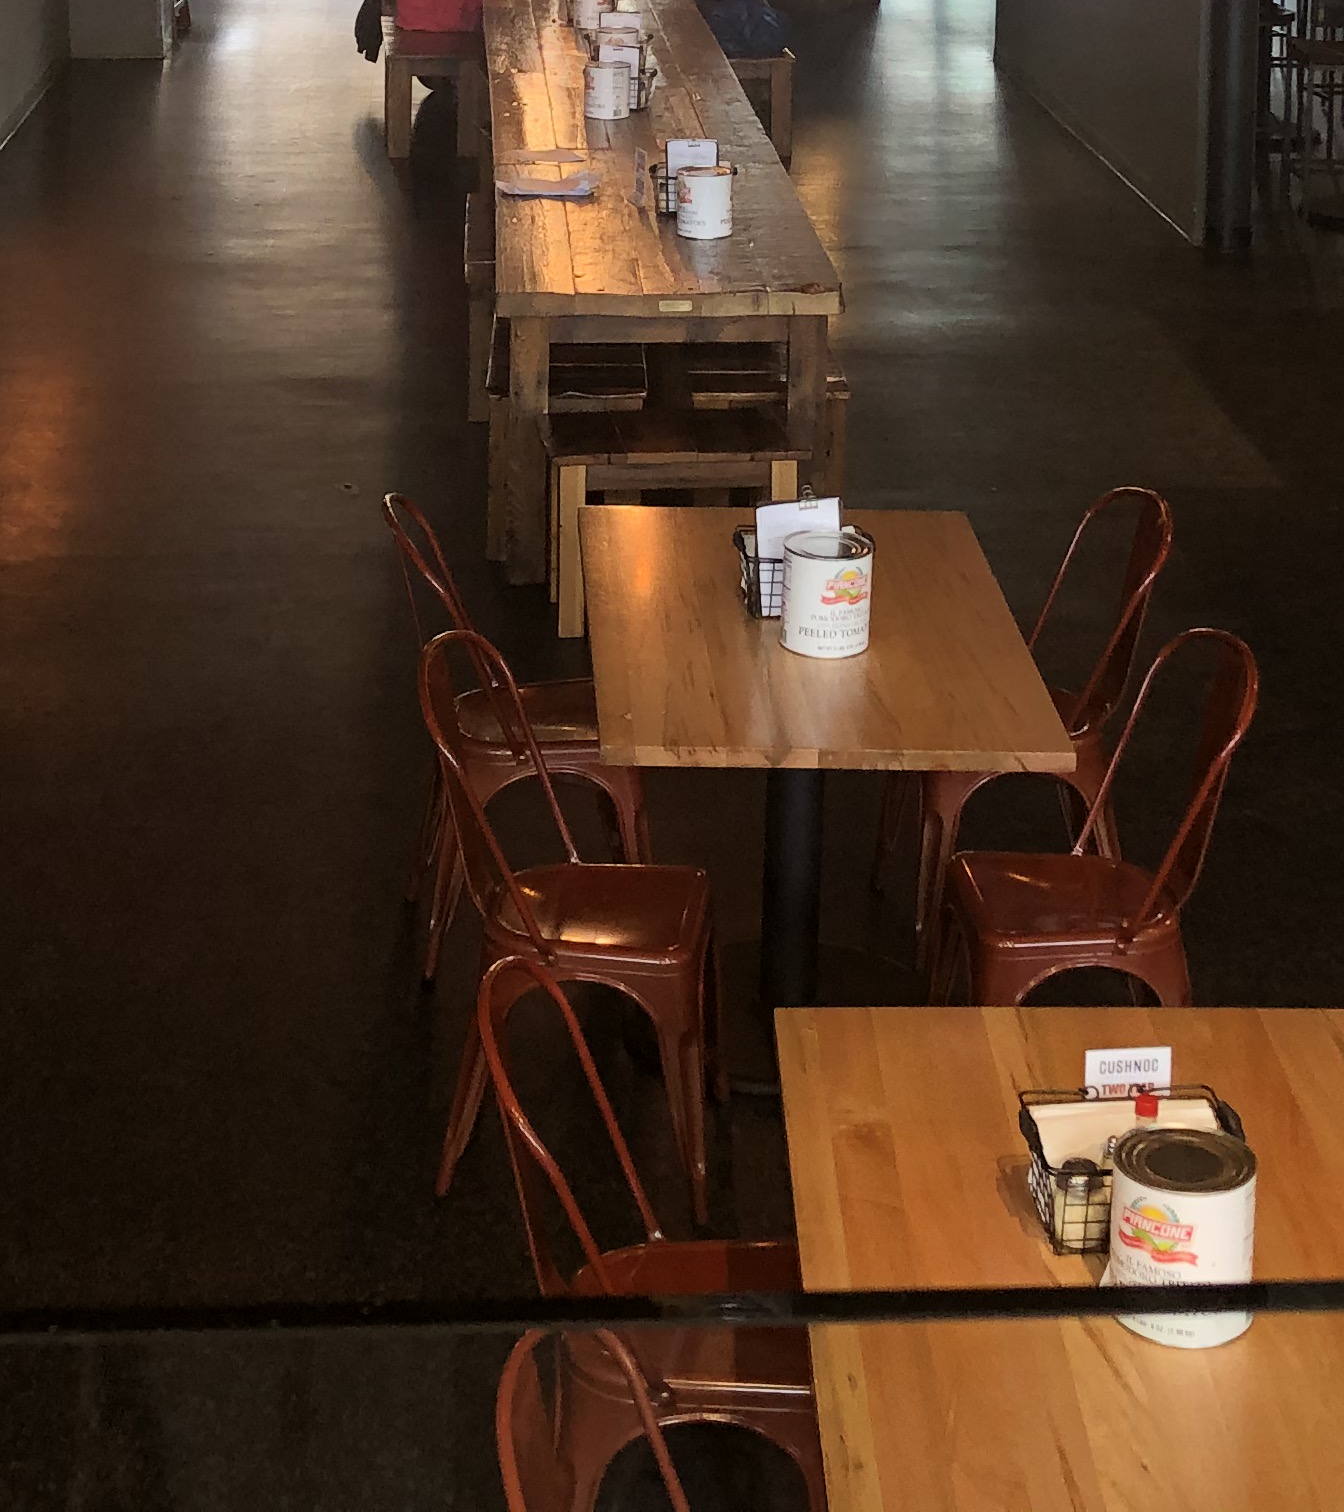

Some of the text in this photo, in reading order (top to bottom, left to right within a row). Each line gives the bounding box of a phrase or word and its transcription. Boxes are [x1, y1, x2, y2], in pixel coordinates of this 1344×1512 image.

[798, 625, 837, 639] PEELED
[1099, 1058, 1159, 1075] CUSHNOC
[1123, 1207, 1193, 1242] PIANCONE
